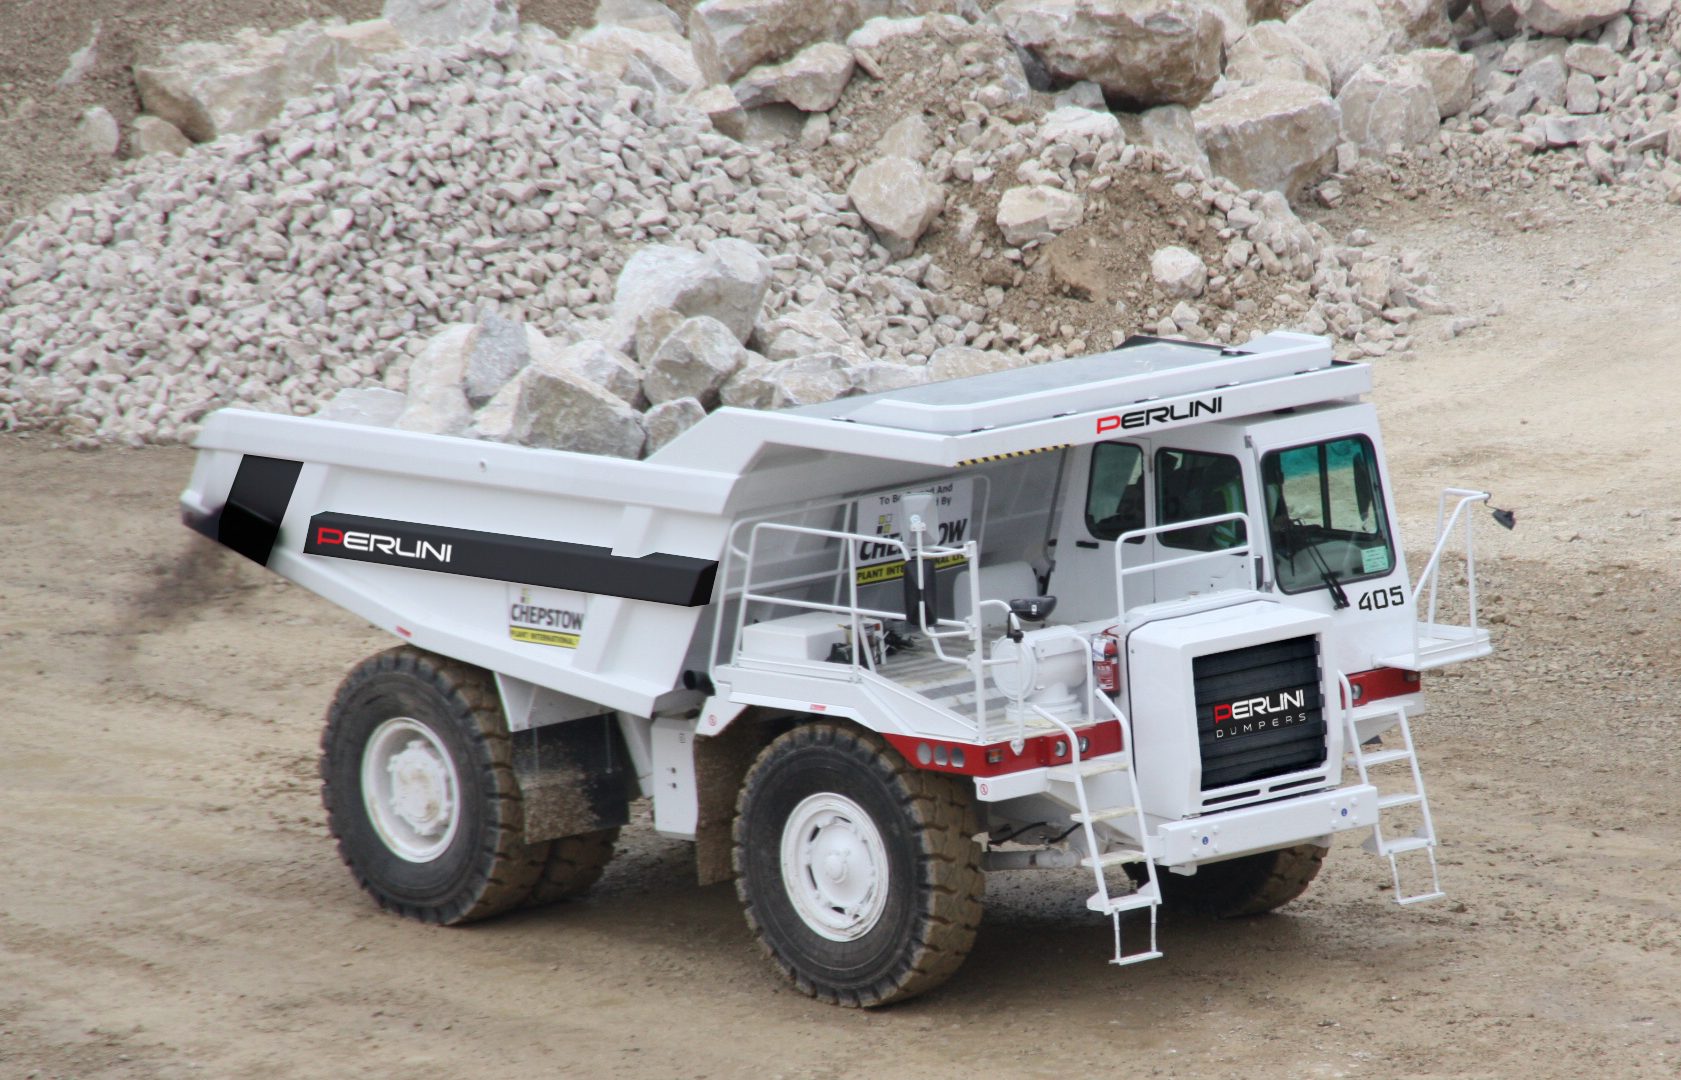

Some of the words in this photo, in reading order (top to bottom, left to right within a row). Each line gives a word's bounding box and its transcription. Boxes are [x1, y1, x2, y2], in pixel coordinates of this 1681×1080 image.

[1096, 396, 1223, 434] PERLINI
[879, 496, 890, 506] To
[937, 483, 953, 494] And
[941, 496, 952, 506] By
[317, 527, 452, 563] PERLINI
[857, 568, 884, 581] PLANT
[1358, 585, 1404, 611] 405
[511, 603, 584, 630] CHEPSTOW
[1214, 689, 1304, 724] PERLINI
[1216, 713, 1306, 738] DUMPERS
